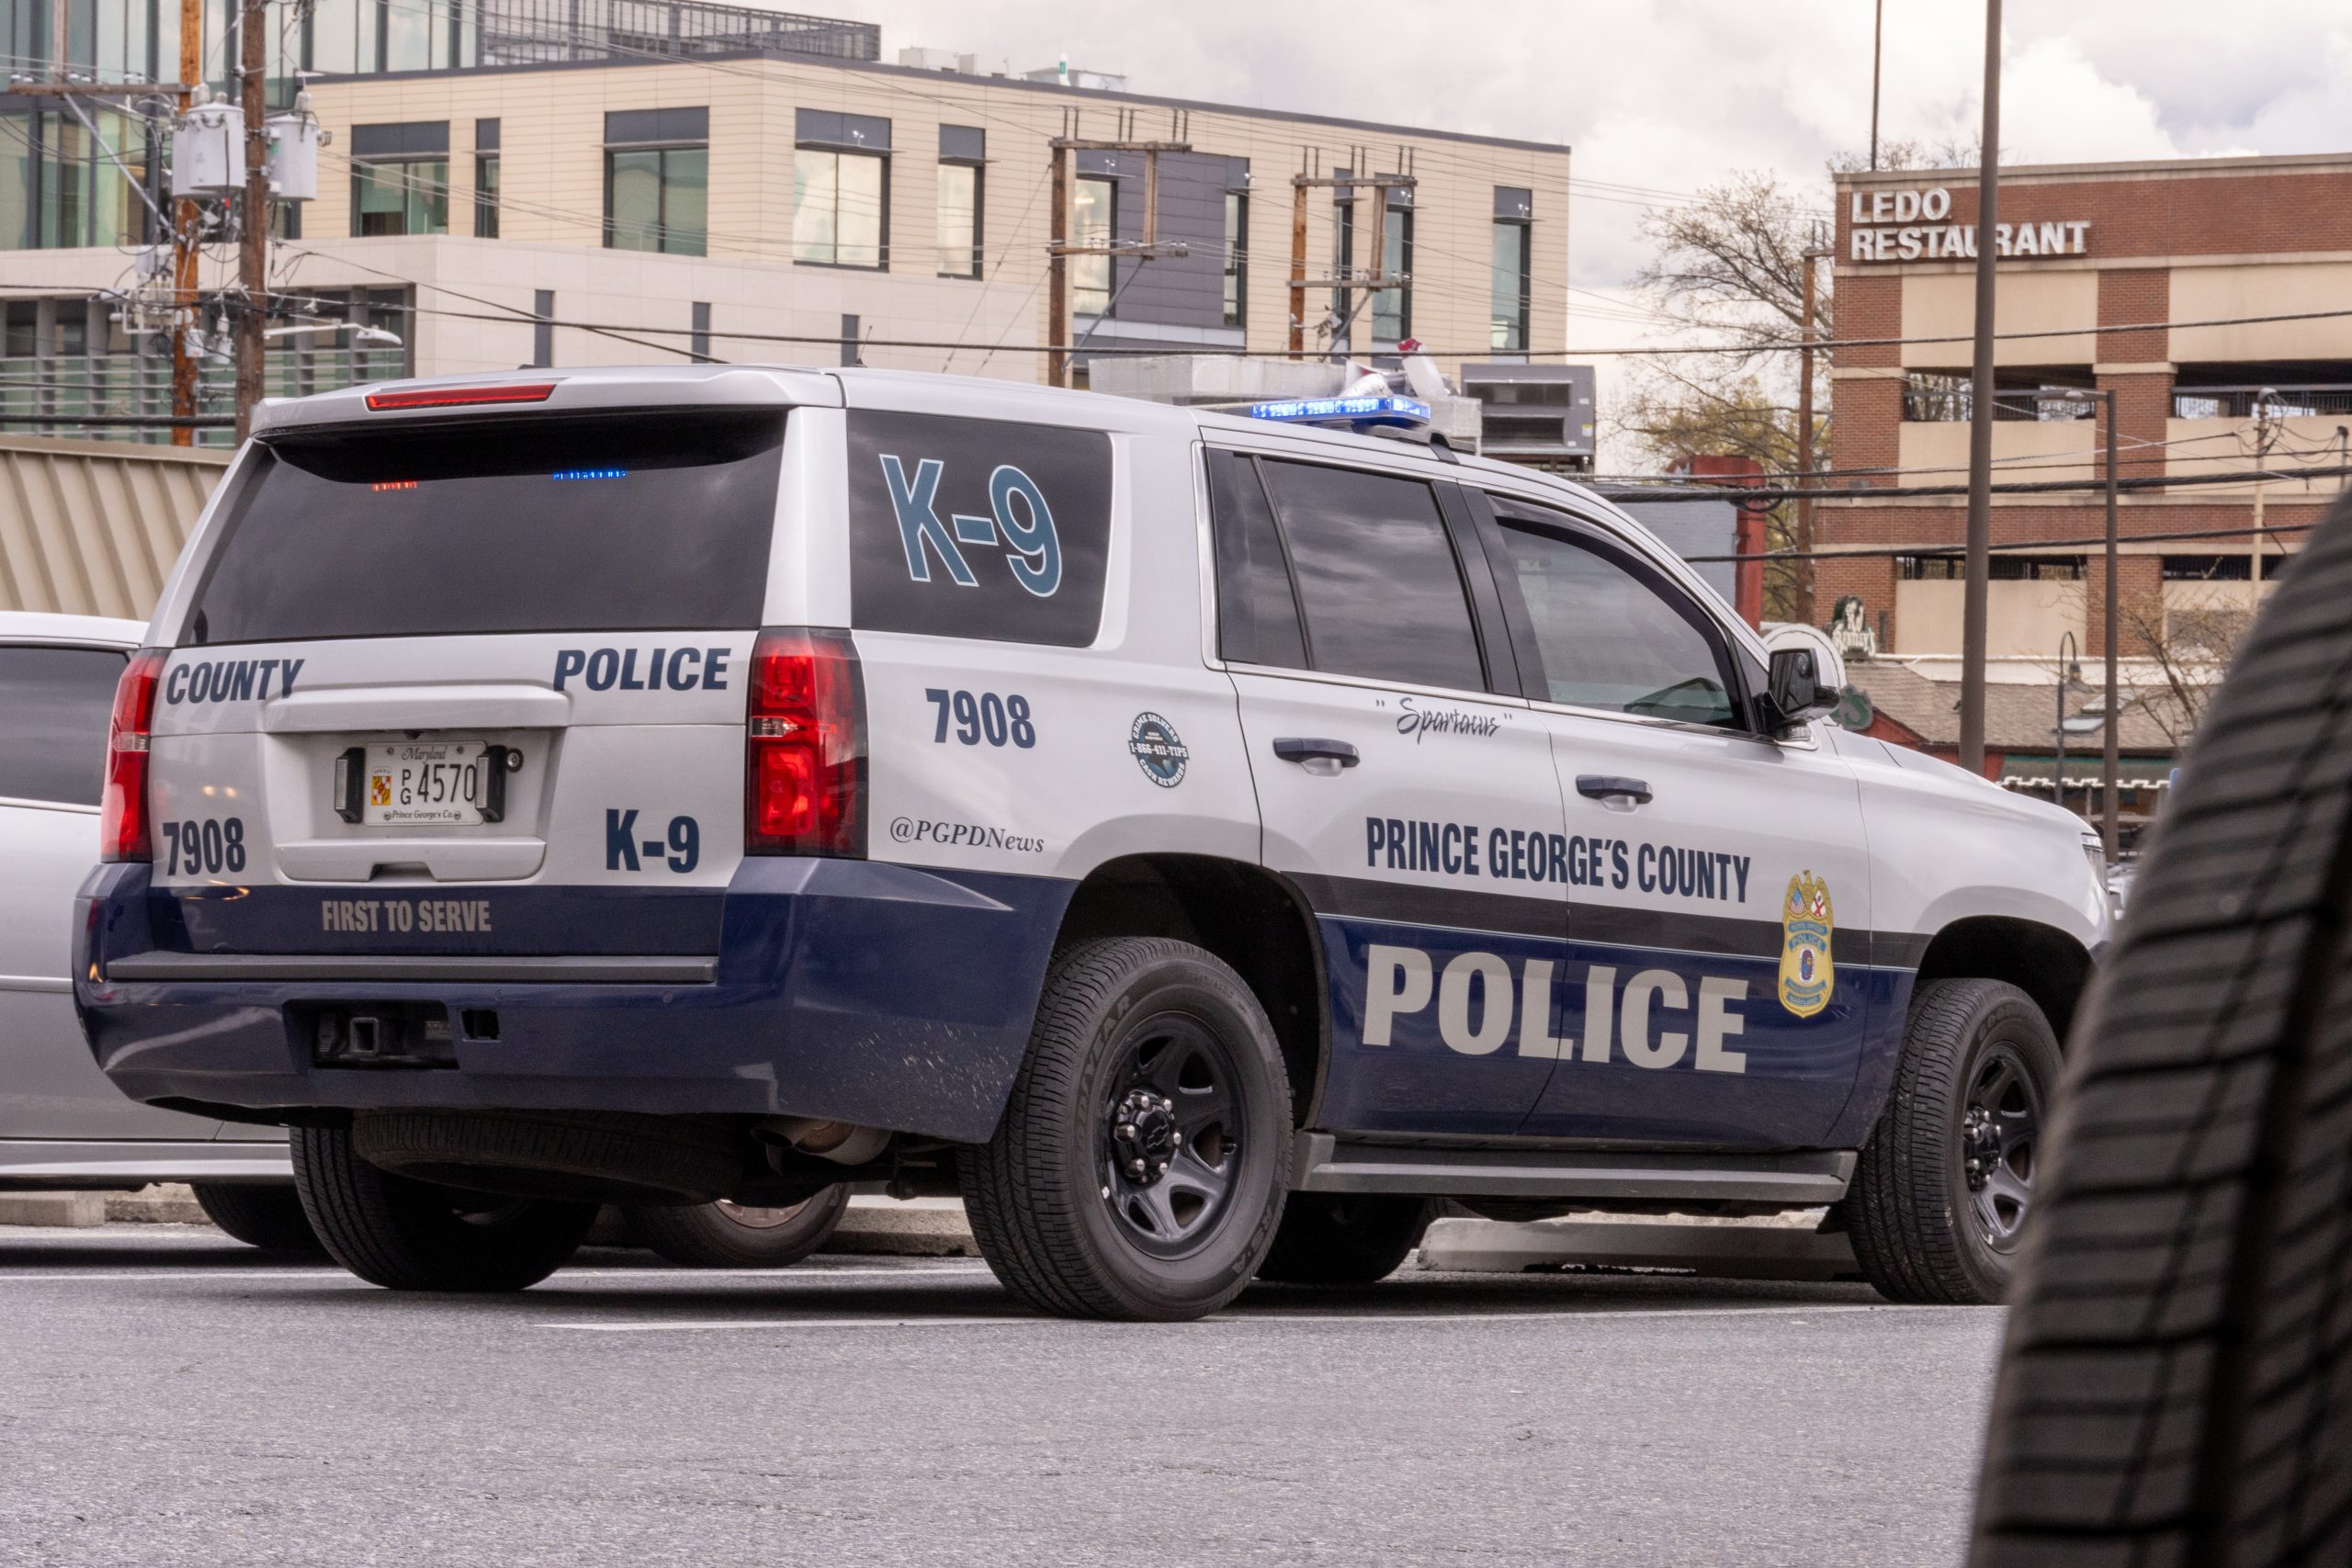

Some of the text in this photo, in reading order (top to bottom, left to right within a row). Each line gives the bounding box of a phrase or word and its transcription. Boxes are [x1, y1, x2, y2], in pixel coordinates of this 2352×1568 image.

[1851, 187, 1951, 223] LEDO
[1851, 220, 2092, 260] RESTAURANT
[878, 454, 1062, 597] K-9
[165, 659, 305, 705] COUNTY
[552, 647, 731, 692] POLICE
[925, 688, 1036, 750] 7908
[401, 745, 448, 764] Maryland
[417, 763, 476, 803] 4570
[391, 809, 413, 818] Prince
[889, 817, 1044, 852] @PGPDNews
[163, 818, 246, 876] 7908
[605, 808, 699, 874] K-9
[1366, 817, 1751, 903] PRINCE GEORGE'S COUNTY
[322, 899, 492, 931] FIRST TO SERVE
[1792, 933, 1822, 949] POLICE
[1362, 943, 1749, 1074] POLICE
